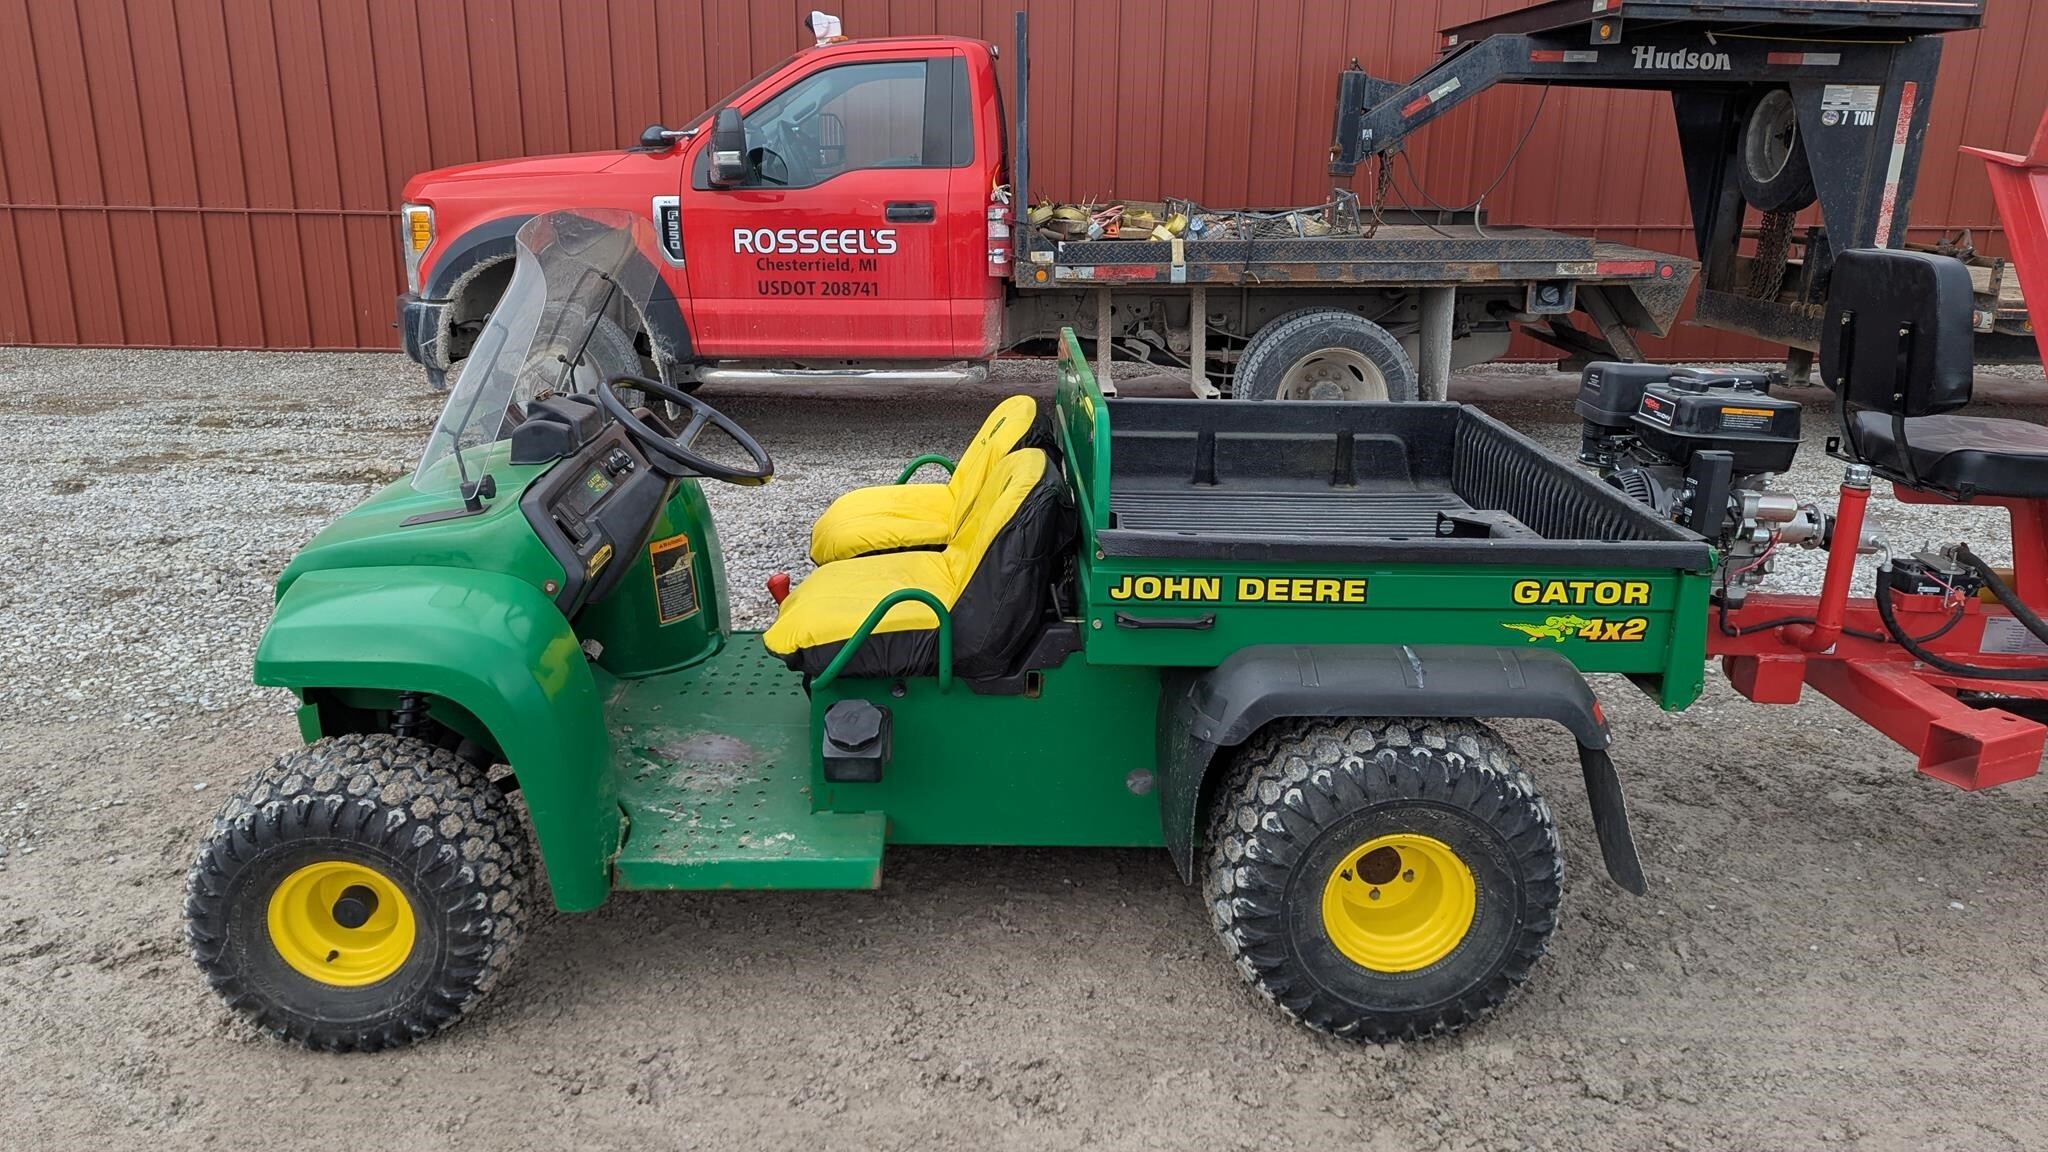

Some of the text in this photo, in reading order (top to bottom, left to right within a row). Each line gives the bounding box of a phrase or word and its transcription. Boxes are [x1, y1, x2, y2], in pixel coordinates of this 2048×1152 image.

[1632, 45, 1731, 71] Hudson
[1841, 111, 1849, 126] 7
[1854, 111, 1876, 126] TON
[733, 228, 898, 254] ROSSEEL'S
[756, 257, 877, 274] Chesterfield, MI
[758, 281, 879, 297] USDOT 208741
[1110, 575, 1367, 603] JOHN DEERE
[1512, 580, 1651, 605] GATOR
[1578, 617, 1648, 642] 4x2
